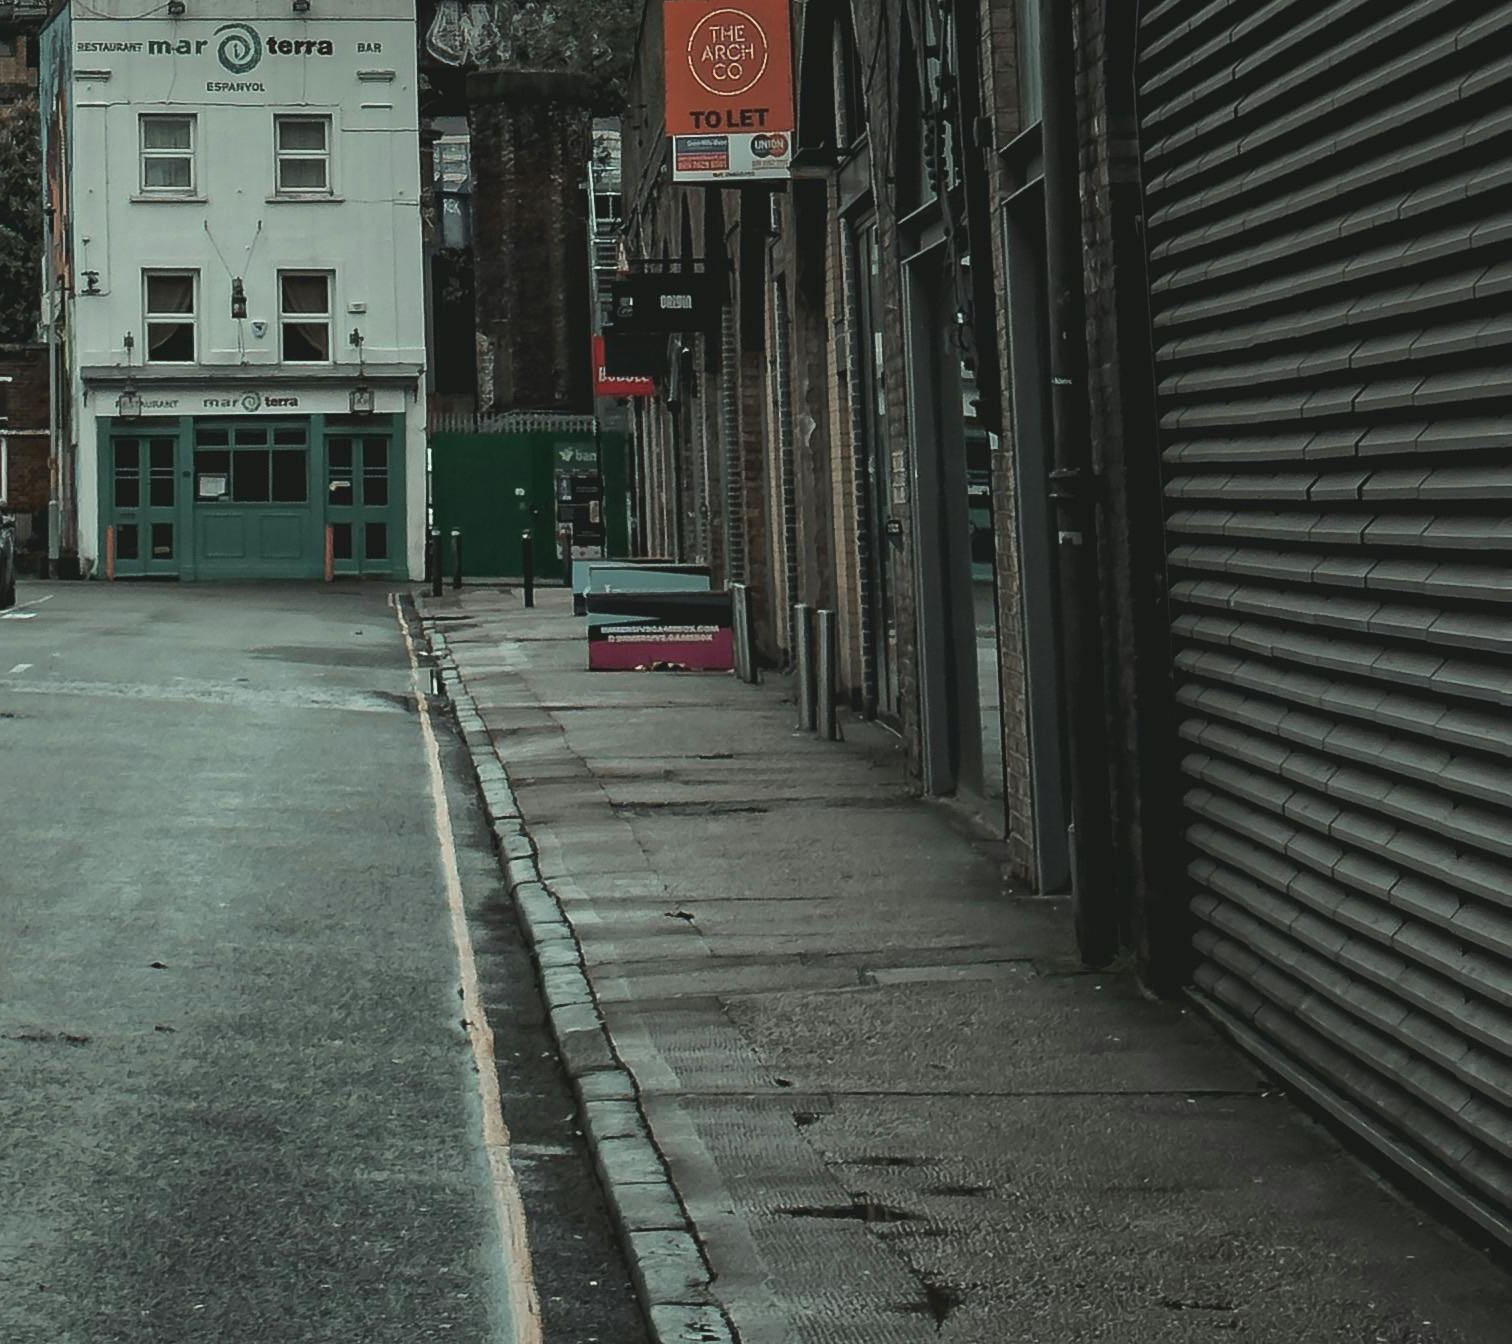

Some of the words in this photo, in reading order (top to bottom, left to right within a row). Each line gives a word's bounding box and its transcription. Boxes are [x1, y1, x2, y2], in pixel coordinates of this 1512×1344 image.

[709, 25, 745, 43] THE
[77, 42, 143, 52] RESTAURANT
[148, 39, 208, 55] mar
[266, 36, 333, 56] terra
[357, 42, 382, 53] BAR
[701, 43, 754, 62] ARCH
[712, 62, 743, 80] CO
[206, 82, 265, 92] ESPANYOL
[689, 110, 722, 129] TO
[726, 108, 770, 128] LET
[754, 138, 784, 150] UNION
[203, 397, 239, 408] mar
[264, 396, 299, 407] terra
